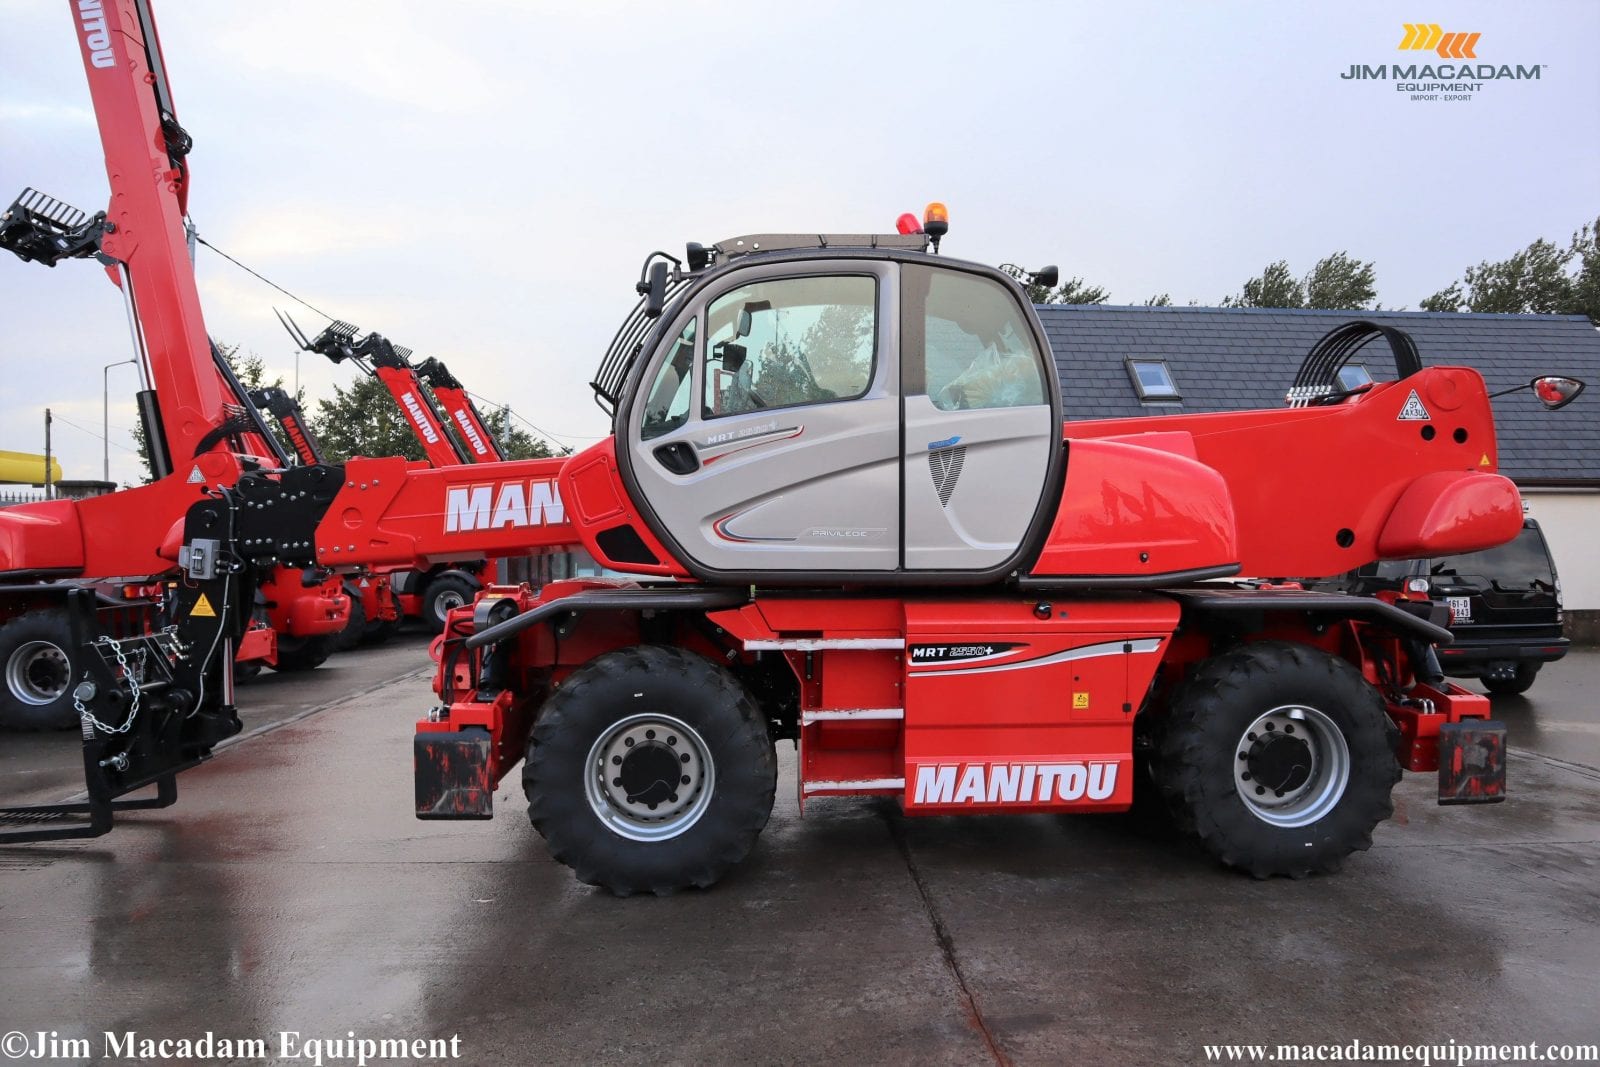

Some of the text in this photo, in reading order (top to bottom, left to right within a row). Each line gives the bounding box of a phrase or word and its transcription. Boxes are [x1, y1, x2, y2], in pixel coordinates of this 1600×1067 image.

[281, 416, 318, 466] MANITOU
[401, 392, 440, 444] MANITOU
[454, 409, 488, 455] MANITOU
[707, 431, 734, 444] MRT
[444, 480, 571, 533] MAN
[912, 646, 993, 657] MRT 2550+
[914, 762, 1119, 804] MANITOU
